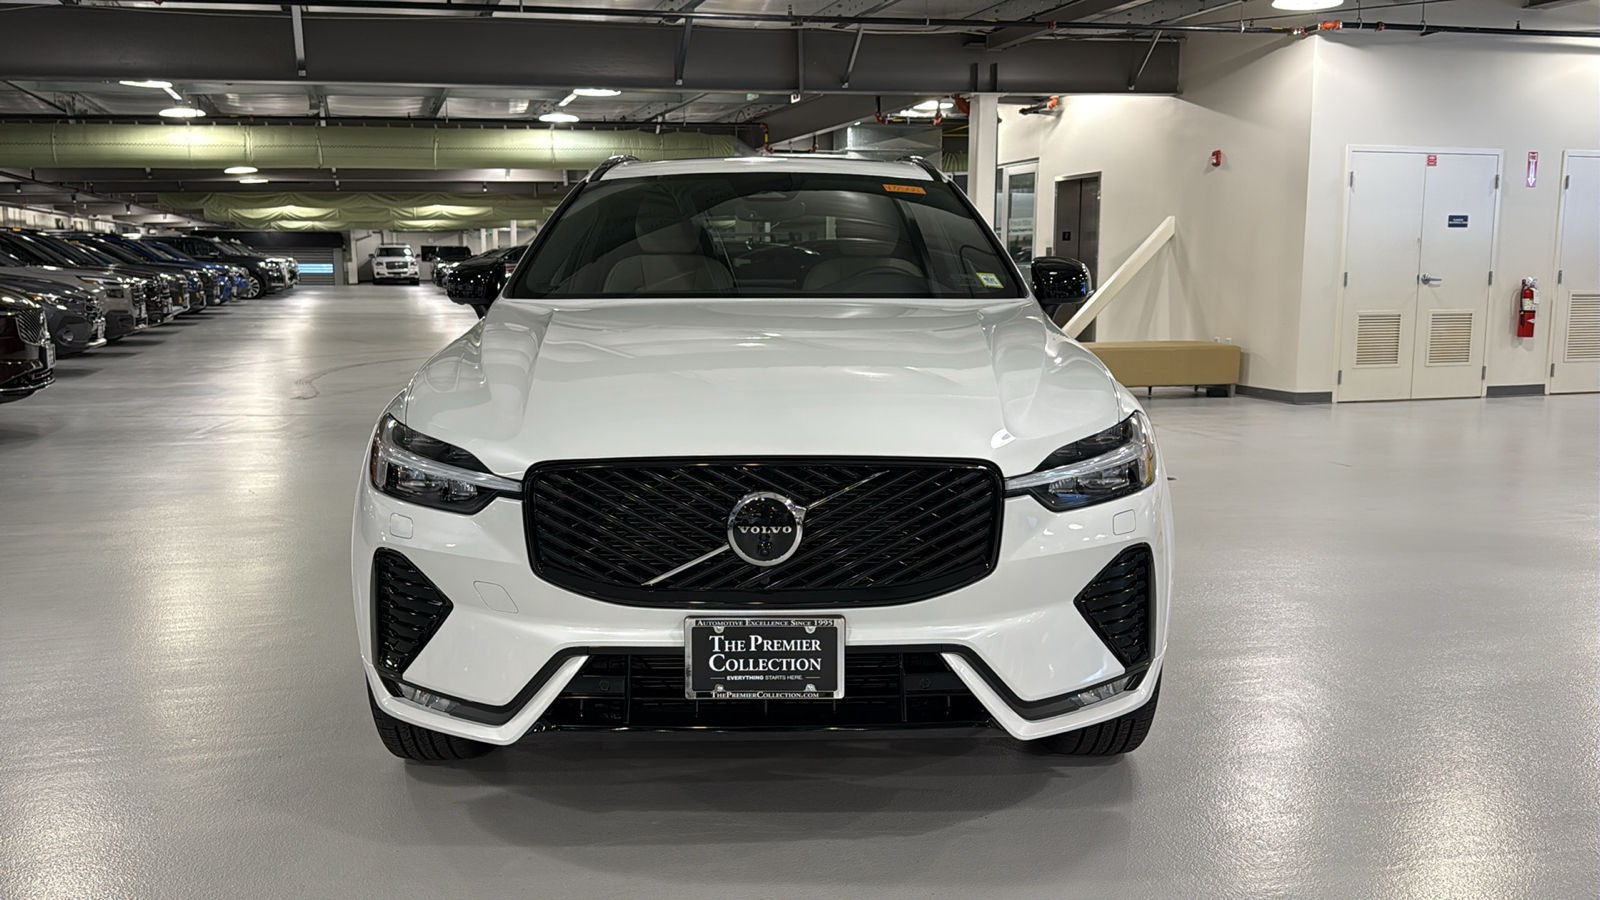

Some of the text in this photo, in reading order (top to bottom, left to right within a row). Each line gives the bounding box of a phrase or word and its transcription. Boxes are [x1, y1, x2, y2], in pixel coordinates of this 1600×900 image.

[738, 526, 792, 534] VOLVO
[709, 635, 822, 652] THE PREMIER
[708, 653, 822, 671] COLLECTION
